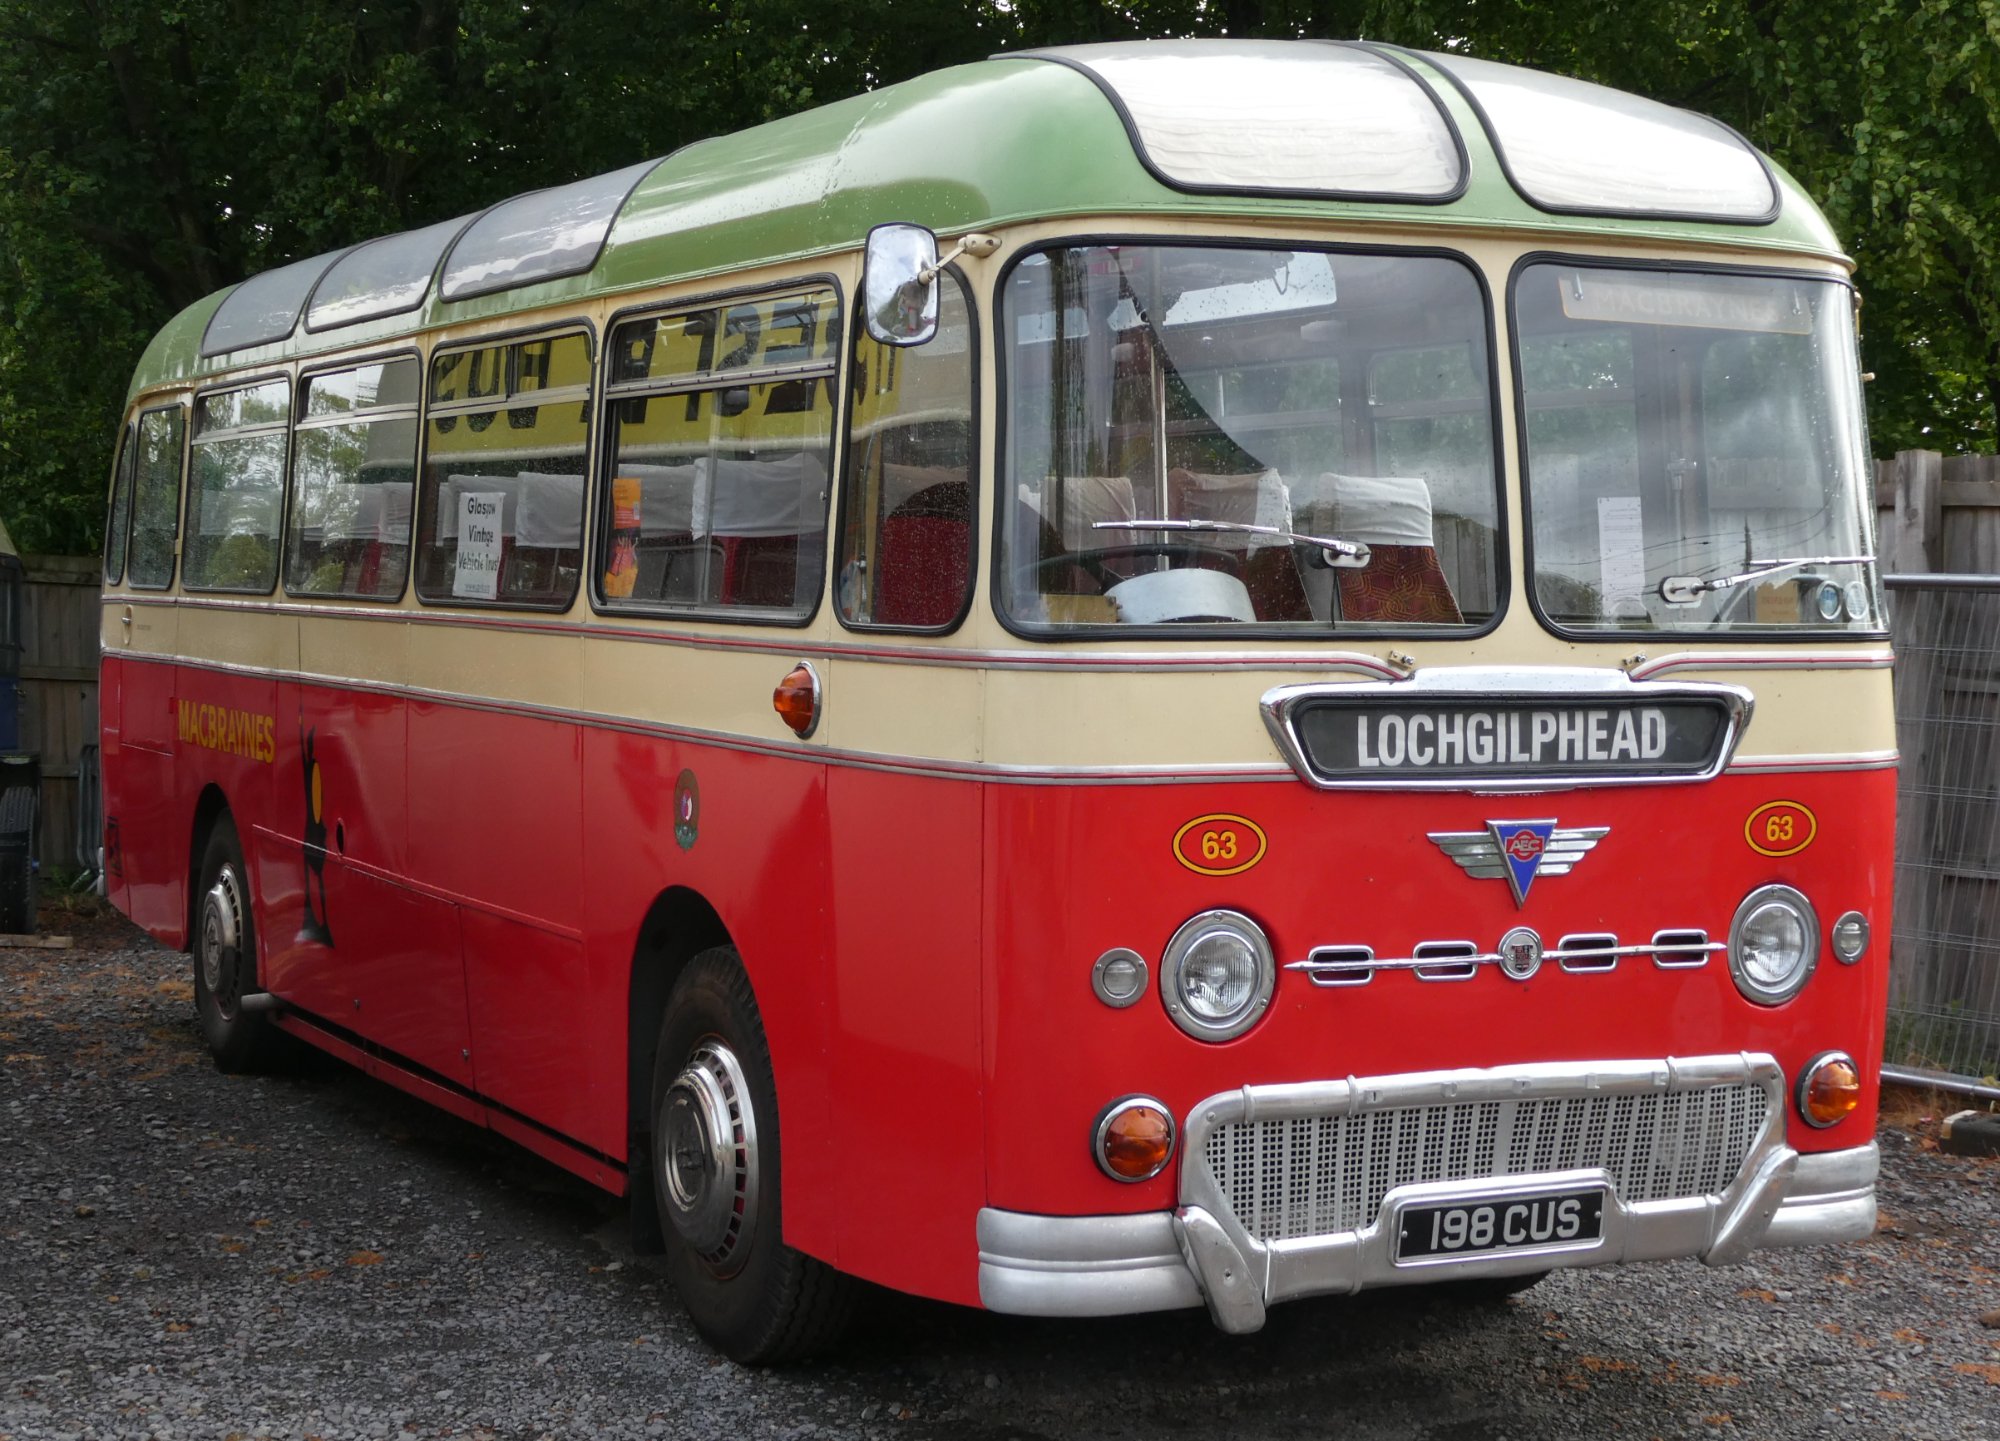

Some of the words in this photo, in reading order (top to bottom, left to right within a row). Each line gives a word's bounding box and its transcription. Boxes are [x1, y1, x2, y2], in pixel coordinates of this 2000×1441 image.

[178, 699, 275, 763] MACBRAYNES
[1357, 709, 1667, 767] LOCHGILPHEAD
[1201, 829, 1238, 860] 63
[1509, 838, 1541, 853] AEC
[1765, 814, 1793, 842] 63
[1430, 1206, 1496, 1250] 198
[1502, 1198, 1582, 1244] CUS
